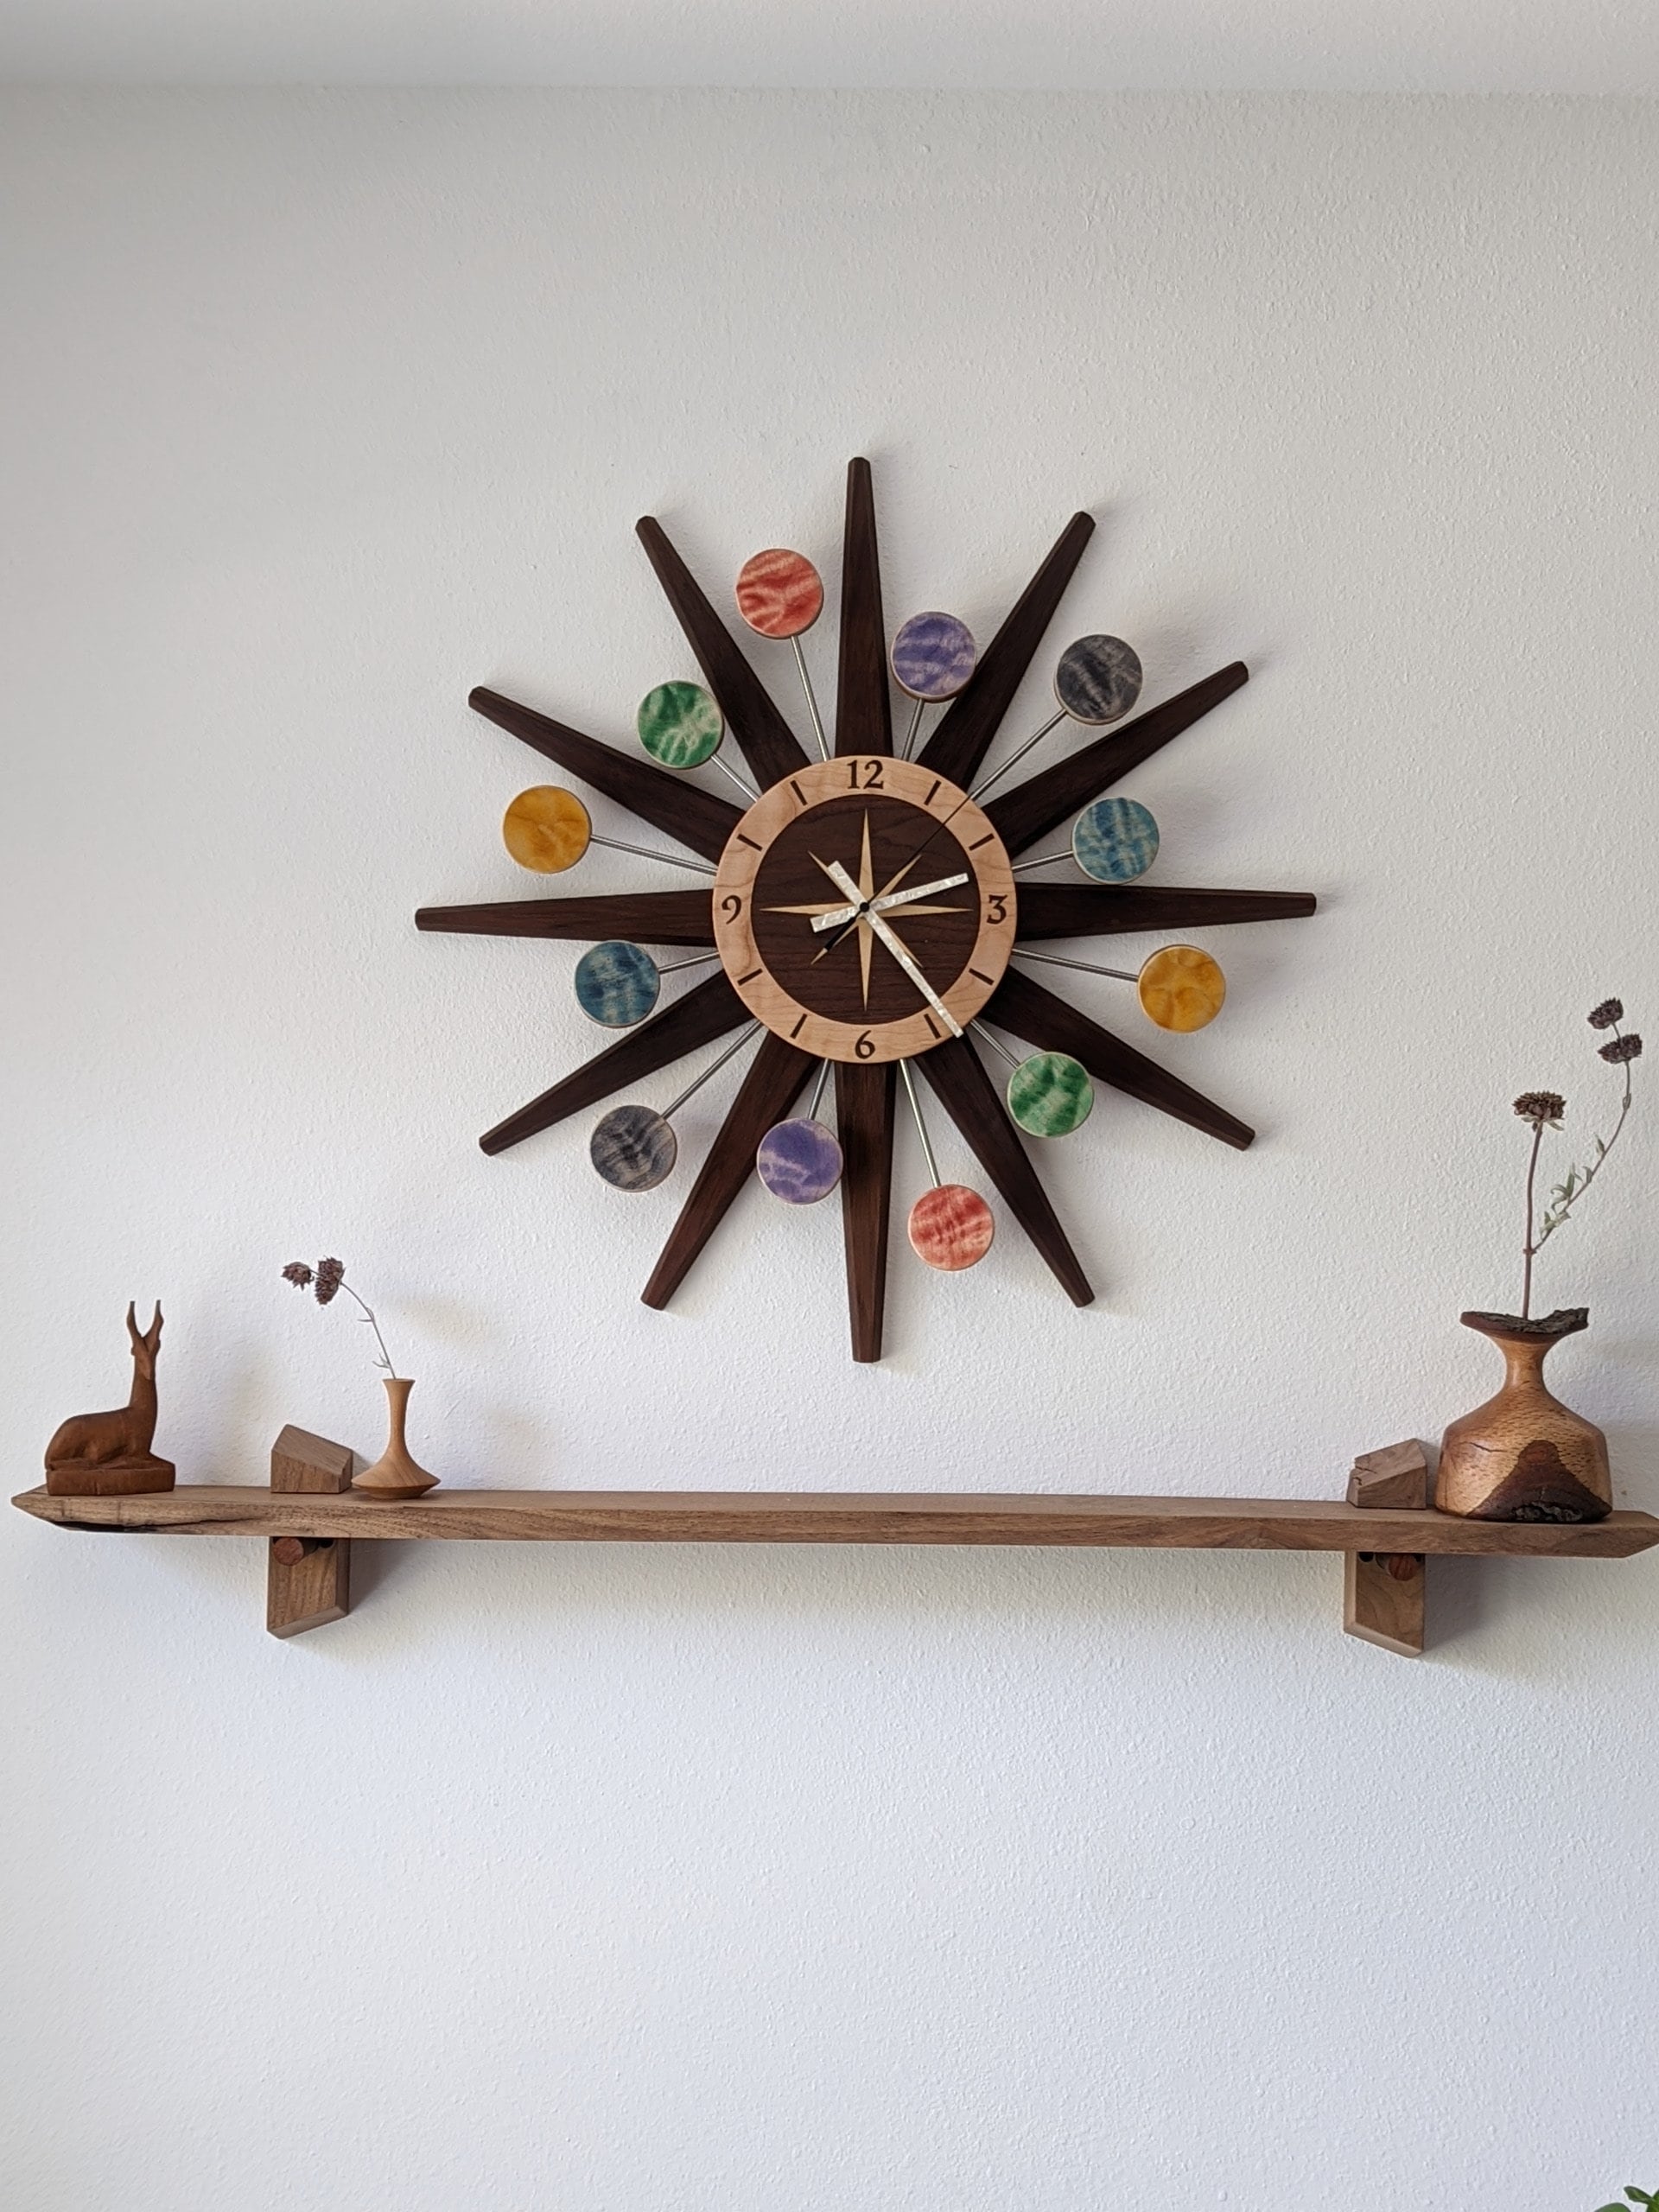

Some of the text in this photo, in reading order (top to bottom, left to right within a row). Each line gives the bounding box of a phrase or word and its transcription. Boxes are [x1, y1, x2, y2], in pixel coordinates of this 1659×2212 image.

[846, 760, 885, 790] 12
[721, 894, 742, 925] 9
[986, 894, 1007, 925] 3
[854, 1030, 876, 1059] 6
